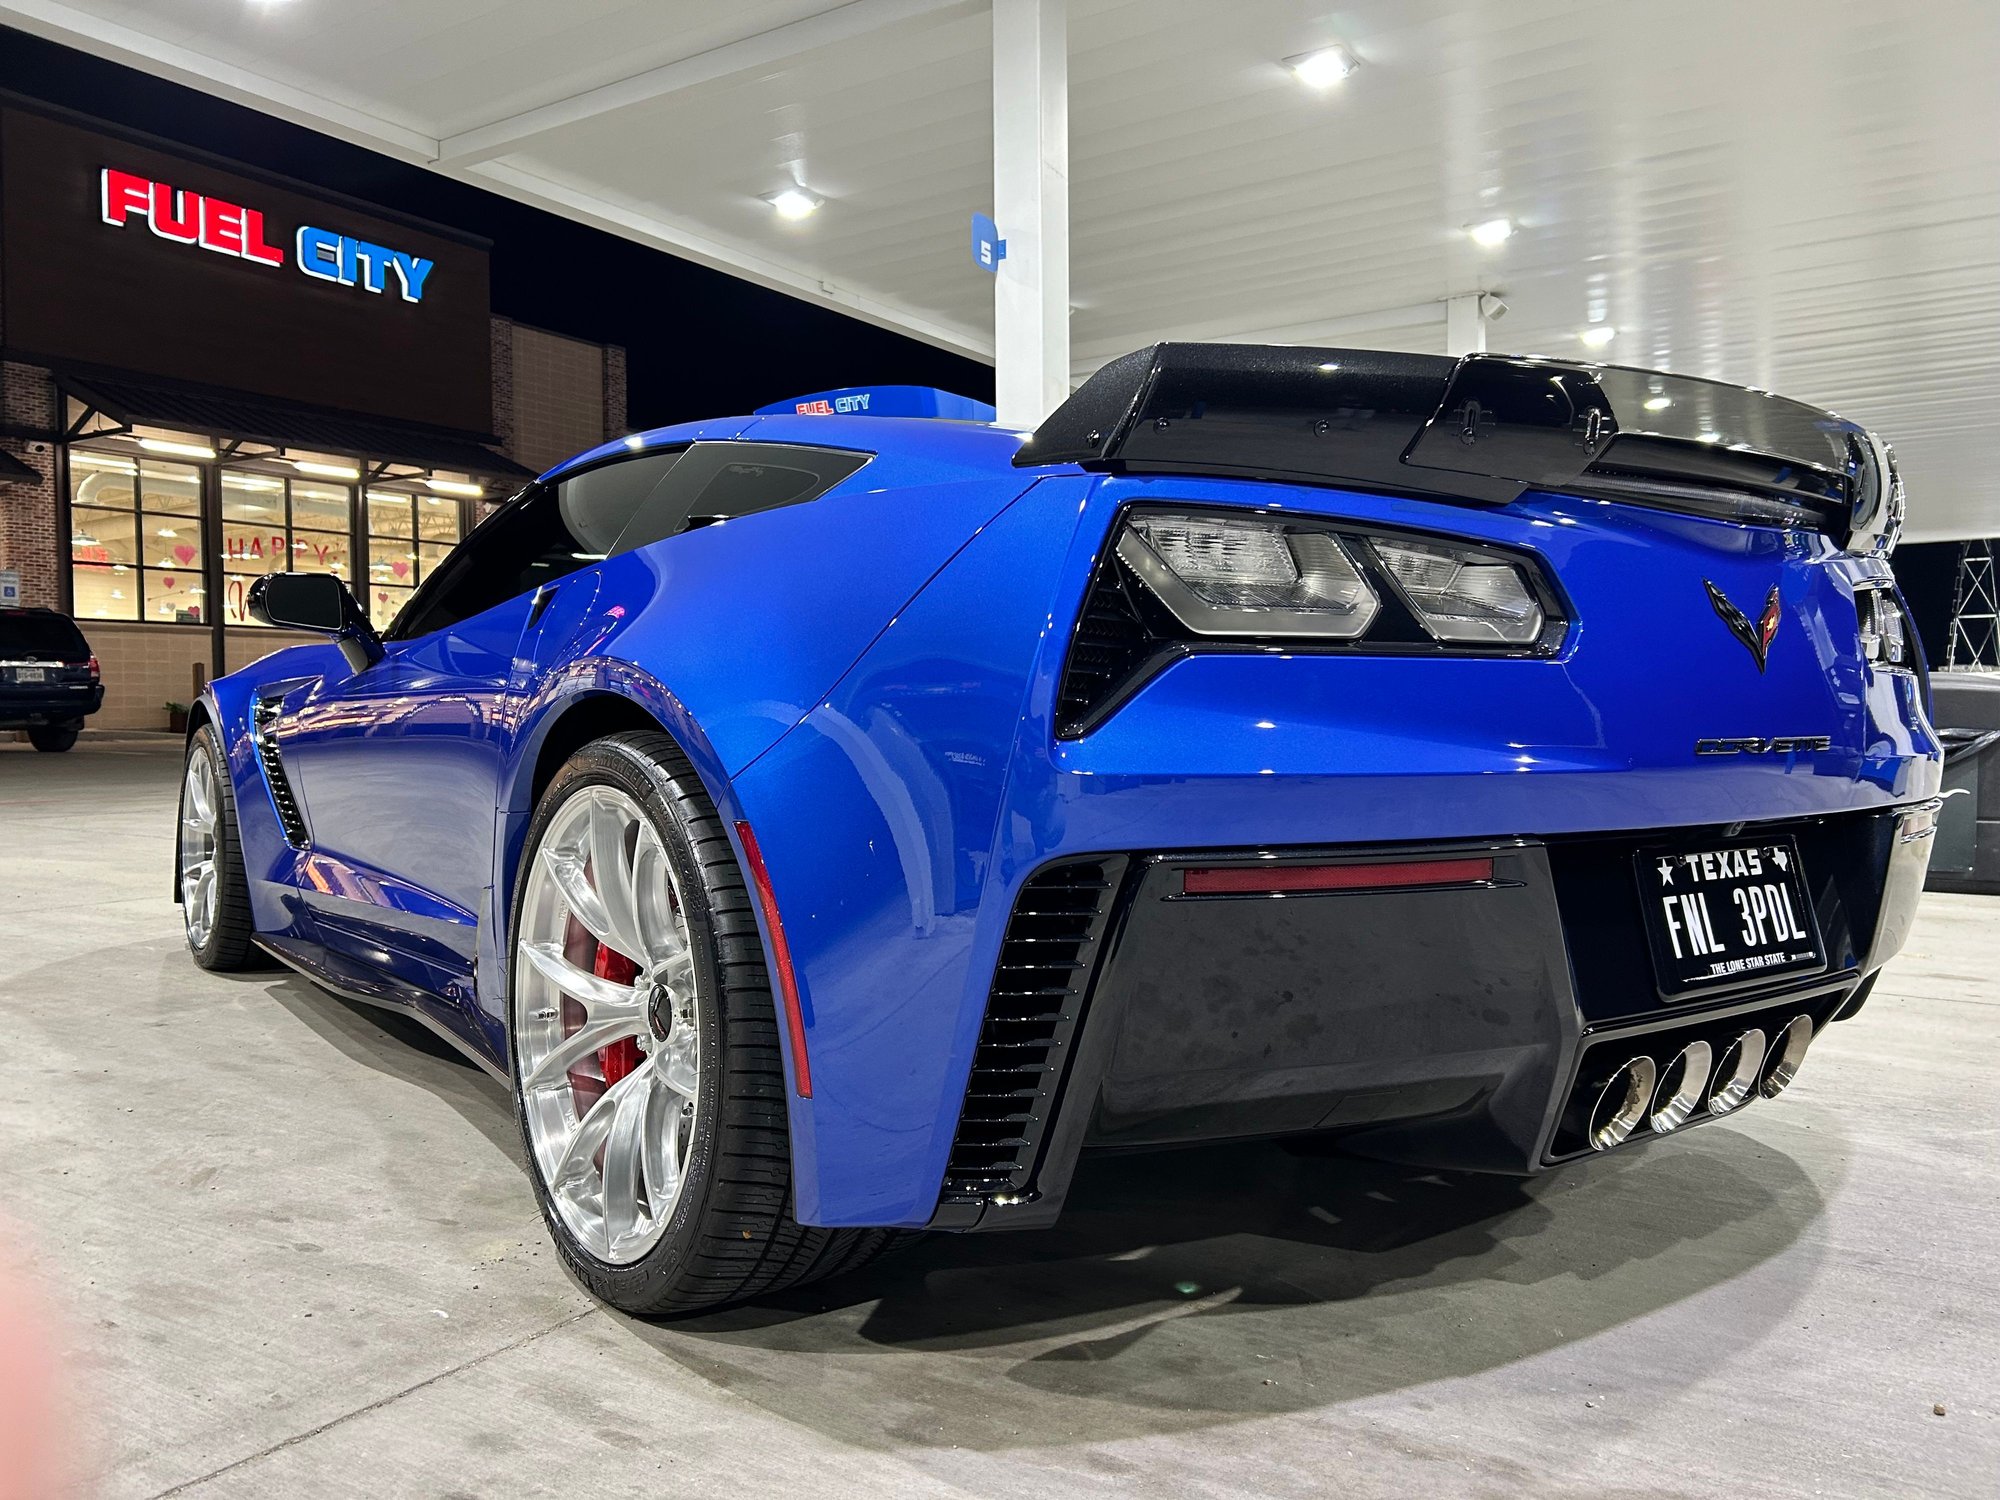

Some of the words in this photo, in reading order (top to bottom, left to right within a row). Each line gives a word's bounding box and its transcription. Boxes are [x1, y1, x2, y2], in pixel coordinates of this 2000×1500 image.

[101, 168, 284, 268] FUEL
[296, 225, 434, 304] CITY
[795, 400, 834, 416] FUEL
[835, 394, 870, 413] CITY
[227, 536, 330, 566] HAPPY
[1685, 849, 1763, 882] TEXAS
[1662, 892, 1726, 959] FNL
[1733, 882, 1807, 947] 3PDL
[1710, 961, 1726, 975] THE
[1726, 957, 1746, 973] LONE
[1746, 954, 1765, 969] STAR
[1766, 951, 1786, 967] STATE
